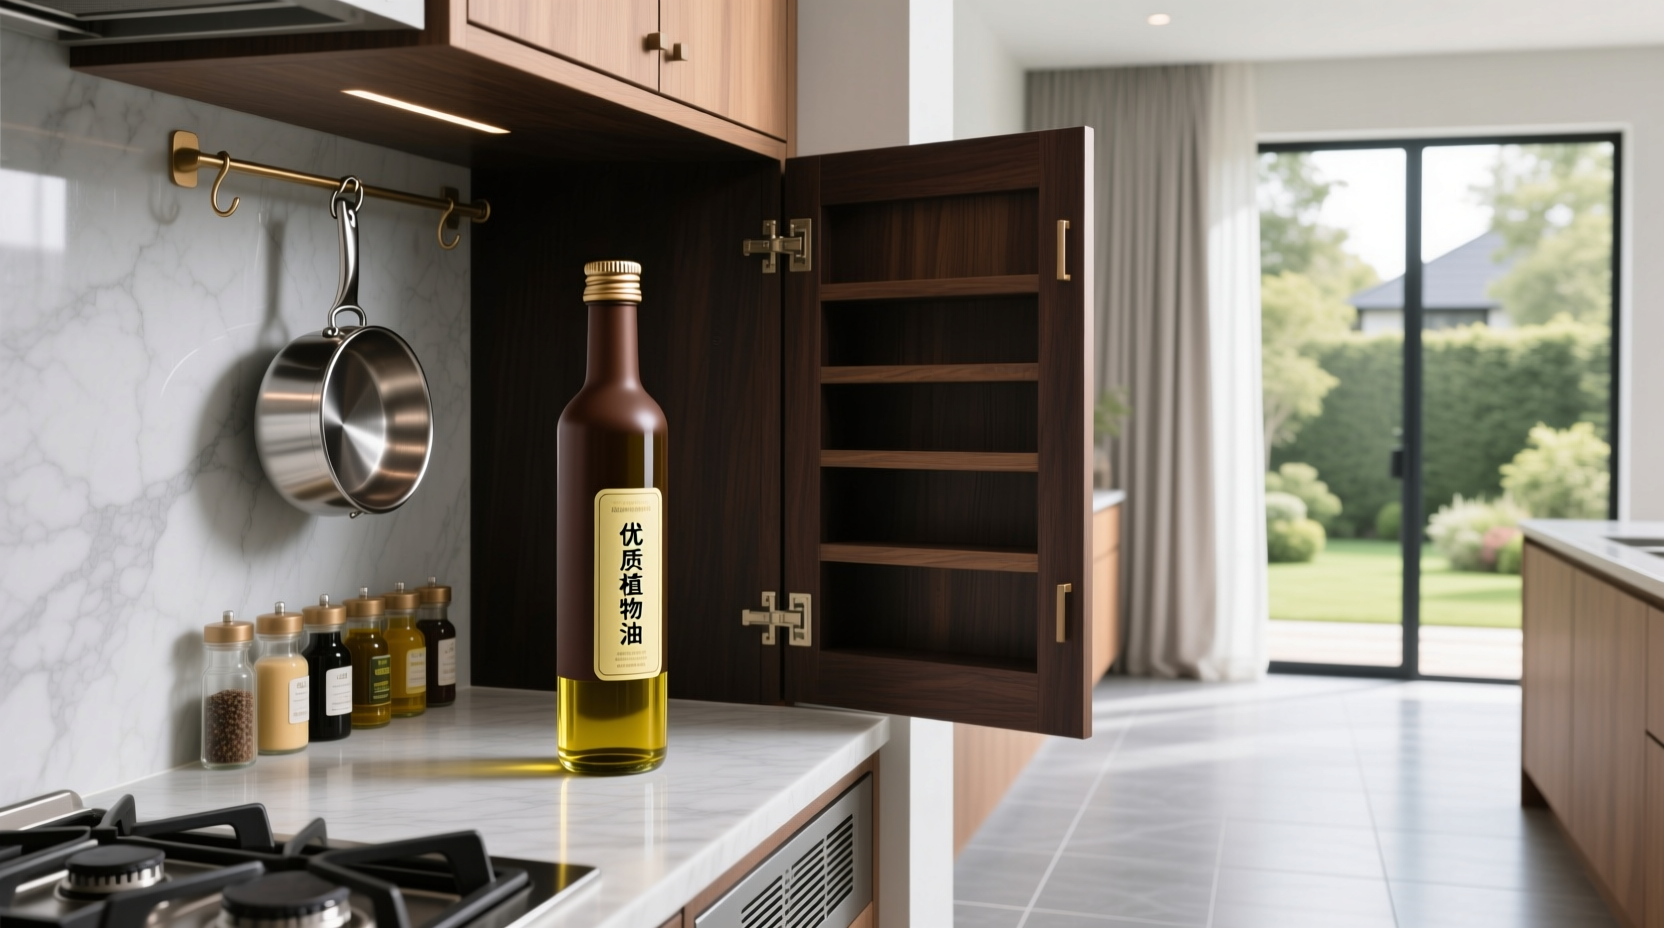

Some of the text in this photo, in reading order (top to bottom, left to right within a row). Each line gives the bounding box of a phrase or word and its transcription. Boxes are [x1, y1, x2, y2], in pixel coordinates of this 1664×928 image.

[618, 521, 644, 646] 优质植物油
